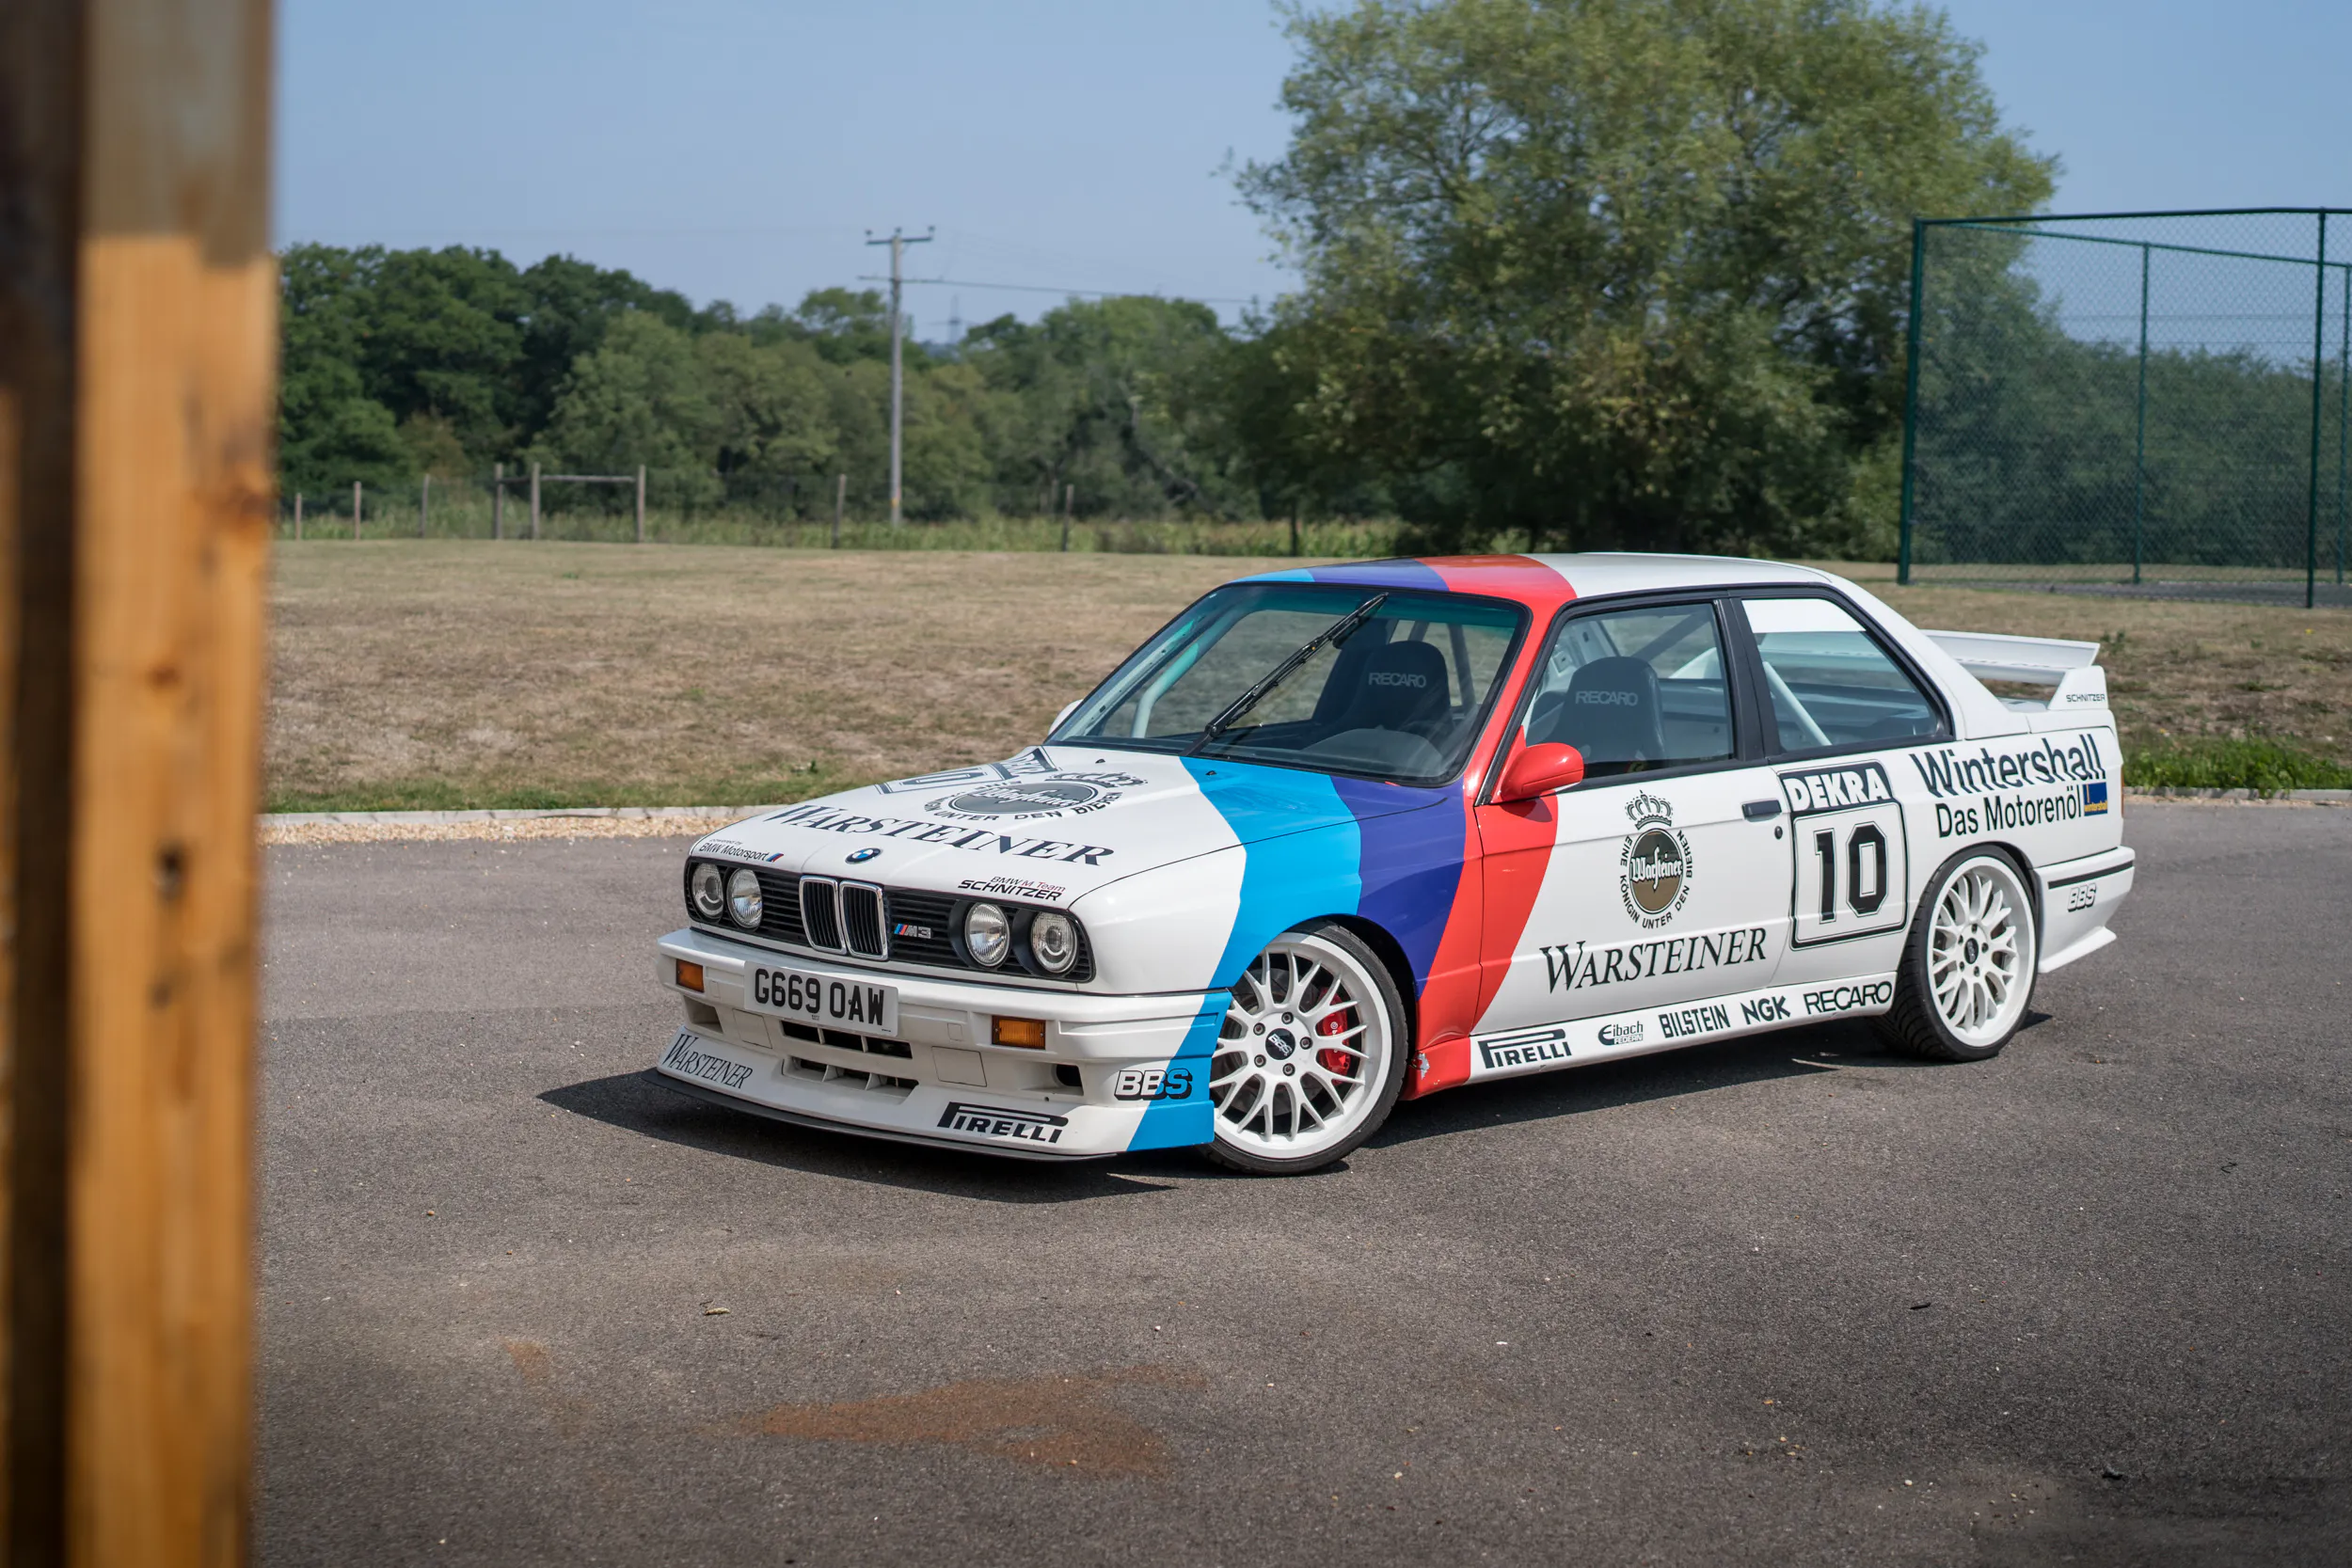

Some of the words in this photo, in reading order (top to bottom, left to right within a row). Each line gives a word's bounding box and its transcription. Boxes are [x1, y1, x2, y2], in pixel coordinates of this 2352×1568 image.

[1368, 672, 1426, 689] RECARO
[1575, 690, 1638, 706] RECARO
[2065, 693, 2106, 703] SCHNITZER
[1910, 734, 2106, 798] Wintershall
[1783, 768, 1891, 812] DEKRA
[1014, 811, 1063, 820] DEN
[1936, 801, 1979, 838] Das
[1983, 784, 2082, 832] Motorenöl
[763, 804, 1115, 865] WARSTEINER
[1620, 834, 1633, 867] EINE
[699, 842, 723, 853] BMW
[721, 846, 769, 861] Motorsport
[1677, 830, 1692, 879] BIEREN
[990, 876, 1024, 886] BMW
[1038, 881, 1066, 893] Team
[1814, 821, 1888, 925] 10
[958, 879, 1062, 901] SCHNITZER
[1619, 875, 1641, 924] KÖNIGIN
[1675, 885, 1690, 911] DEN
[2068, 882, 2097, 912] BBS
[901, 924, 932, 939] M3
[1642, 911, 1673, 929] UNTER
[1539, 927, 1767, 994] WARSTEINER
[755, 968, 821, 1014] G669
[829, 982, 884, 1026] OAW
[1740, 995, 1791, 1025] NGK
[1804, 980, 1893, 1015] RECARO
[1597, 1021, 1644, 1045] Eibach
[1658, 1004, 1731, 1038] BILSTEIN
[661, 1034, 754, 1089] WARSTEINER
[1477, 1029, 1572, 1069] PIRELLI
[1114, 1068, 1193, 1101] BBS
[937, 1101, 1069, 1144] PIRELLI
